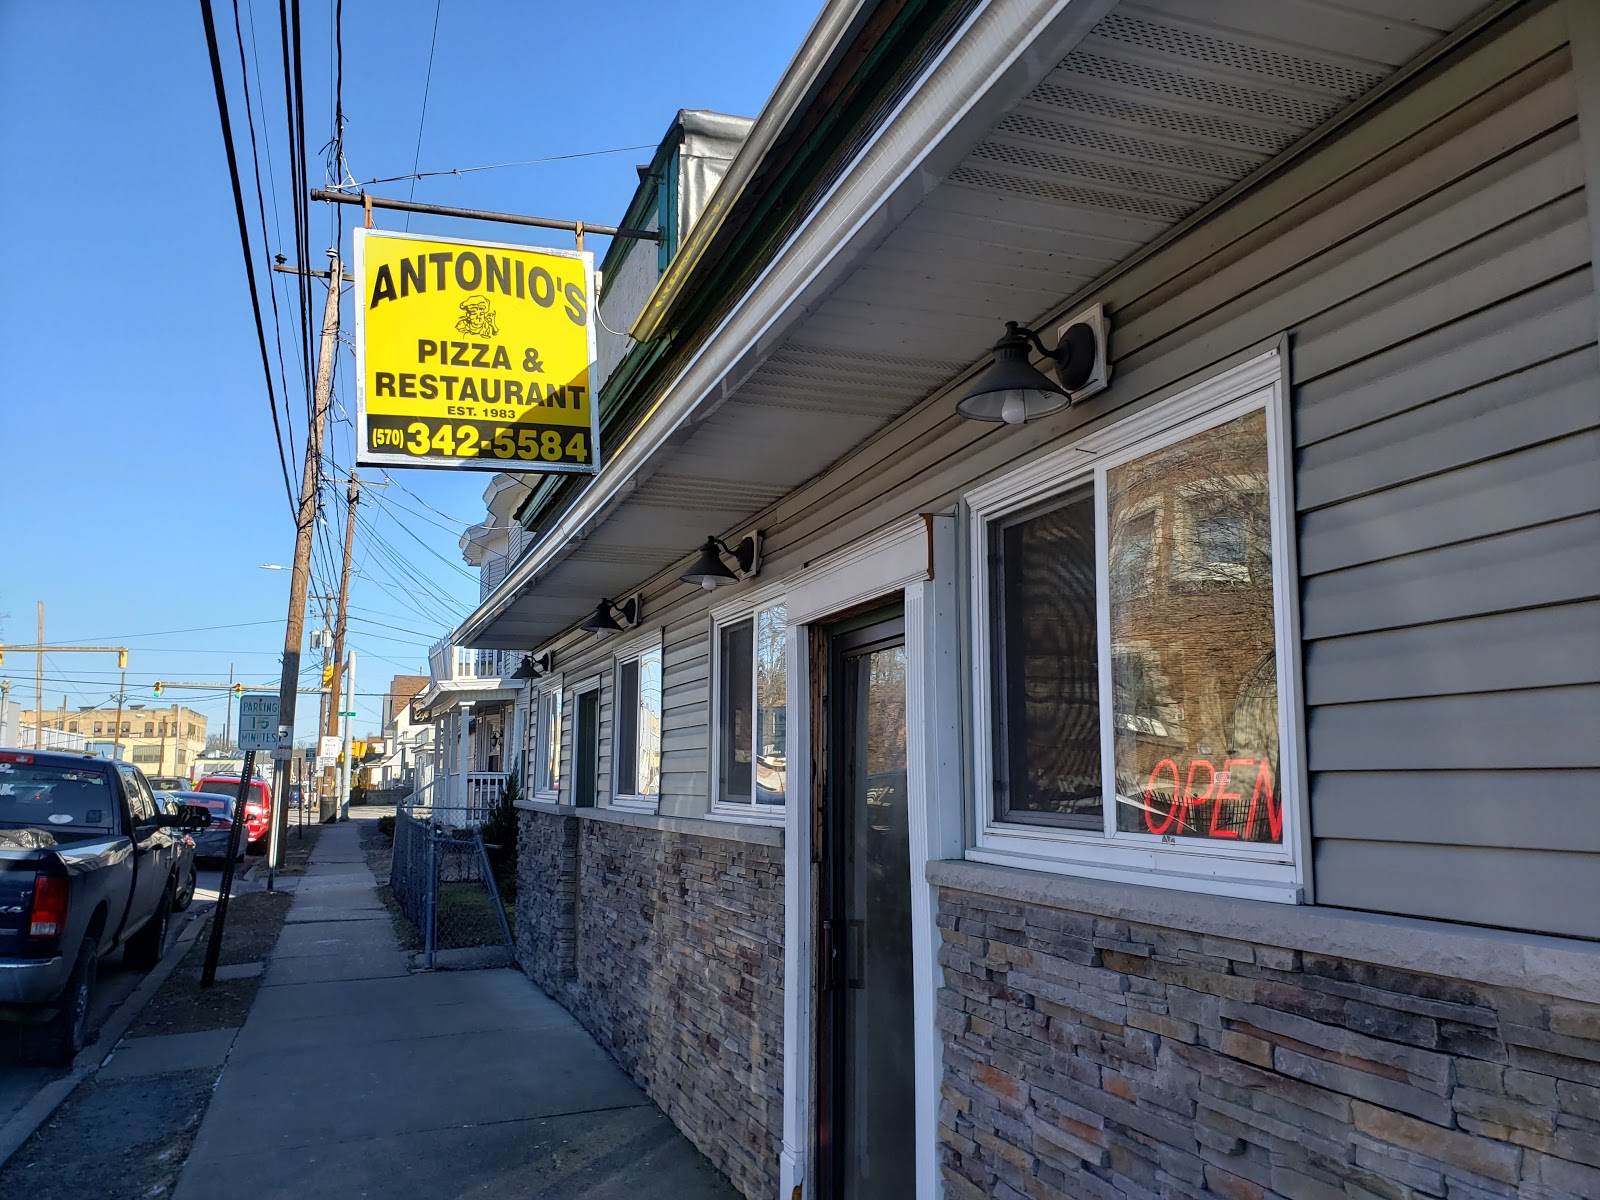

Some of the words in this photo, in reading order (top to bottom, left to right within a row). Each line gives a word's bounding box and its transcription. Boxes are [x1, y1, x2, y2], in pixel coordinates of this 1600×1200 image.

[370, 251, 587, 327] ANTONIO'S
[418, 339, 512, 371] PIZZA
[522, 347, 545, 374] &
[375, 372, 585, 410] RESTAURANT
[447, 405, 477, 417] EST.
[482, 408, 516, 419] 1983
[372, 428, 404, 449] (570)
[407, 422, 588, 462] 342-5584
[243, 702, 278, 713] PARKING
[1144, 757, 1283, 841] OPEN
